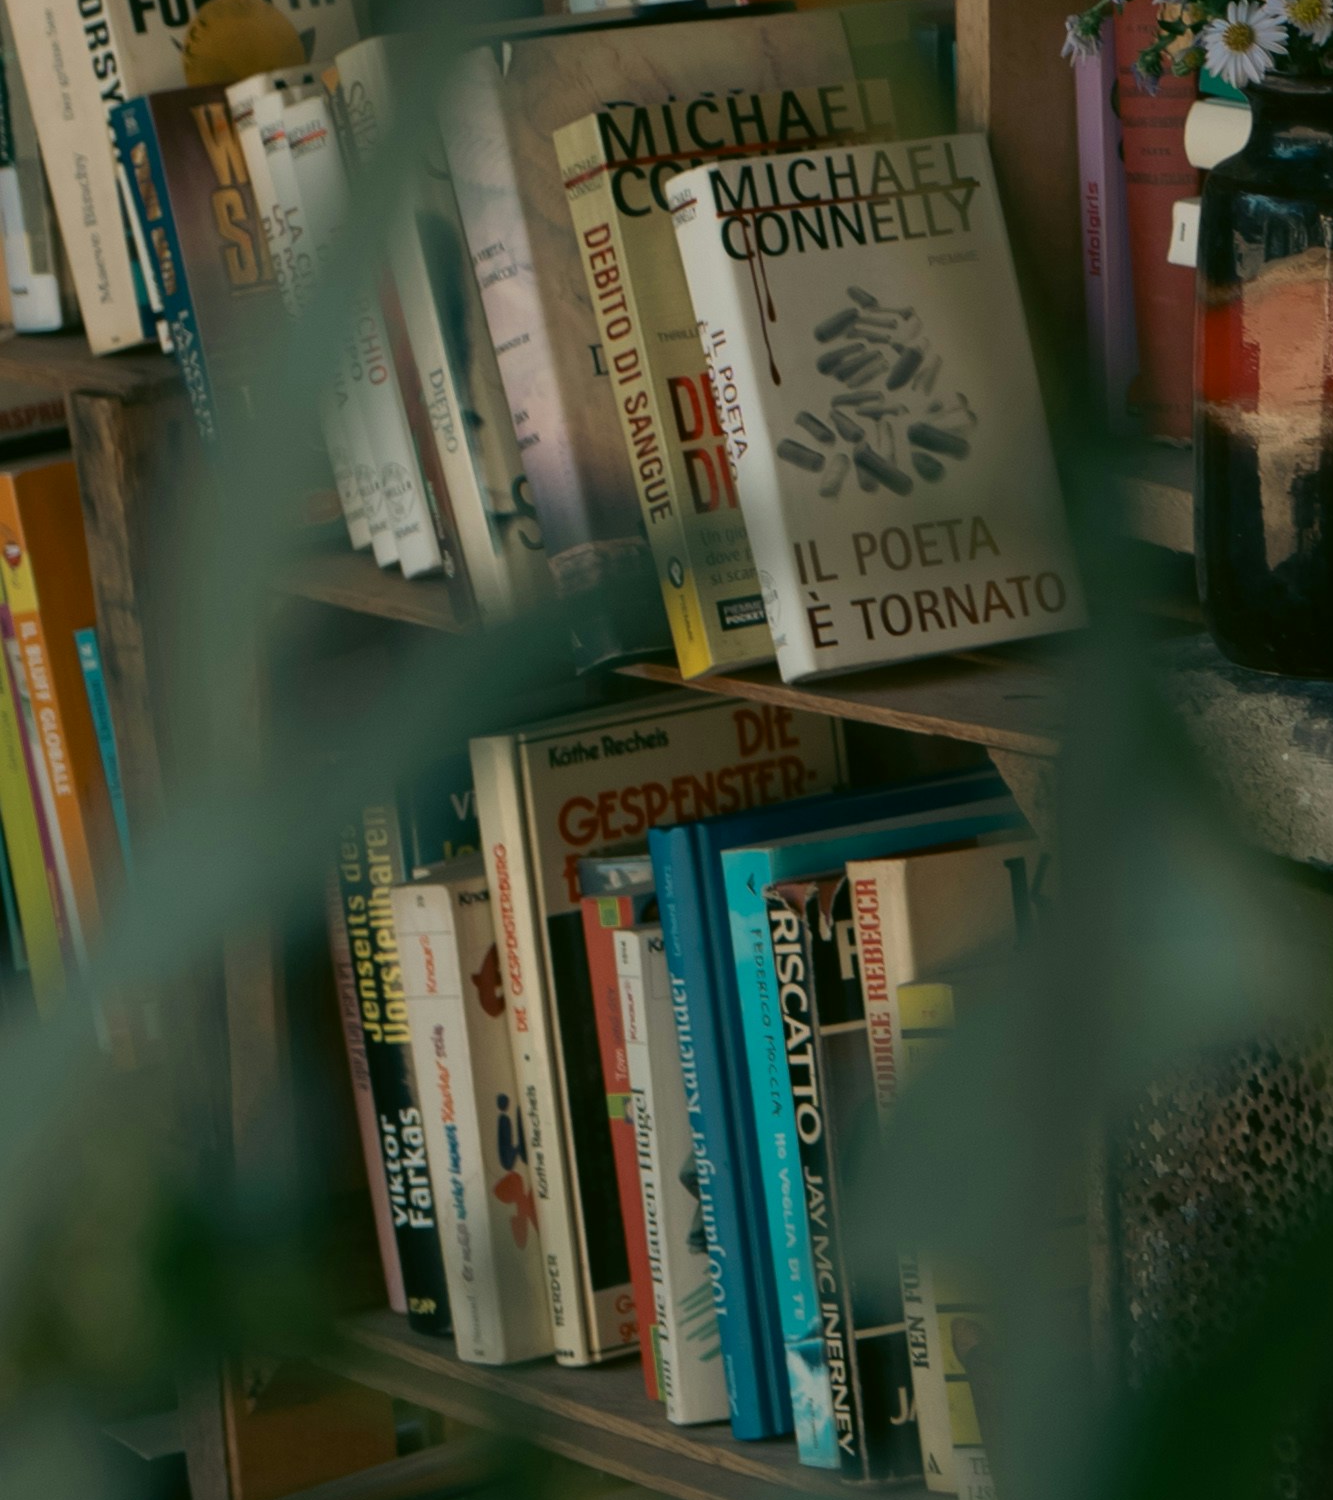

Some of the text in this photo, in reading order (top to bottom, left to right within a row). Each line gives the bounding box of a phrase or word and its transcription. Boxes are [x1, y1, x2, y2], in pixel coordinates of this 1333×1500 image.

[598, 83, 897, 168] MICHAEL
[708, 141, 978, 218] MICHAEL
[720, 188, 977, 262] CONNELLY
[582, 222, 674, 525] DEBITO DI SANGUE
[717, 366, 750, 460] POETA
[792, 514, 1001, 587] IL POETA
[807, 570, 1067, 649] È TORNATO
[38, 706, 73, 797] GLOBALE
[548, 726, 670, 769] Käthe Recheis
[731, 703, 800, 758] DIE
[557, 754, 818, 847] GESPENSTER-
[346, 893, 383, 1044] Jenseits
[749, 928, 783, 1117] FEDERICO MOCCIA
[769, 910, 821, 1146] RISCATTO
[380, 1115, 409, 1228] Viktor
[398, 1107, 435, 1230] Farkas
[631, 1087, 653, 1173] Hügel
[669, 971, 729, 1317] 100jähriger Kalender
[646, 1182, 665, 1285] Blauen
[547, 1253, 565, 1327] HERDER
[655, 1293, 670, 1342] Die
[803, 1165, 857, 1458] JAY MC INERNEY
[907, 1315, 930, 1370] KEN
